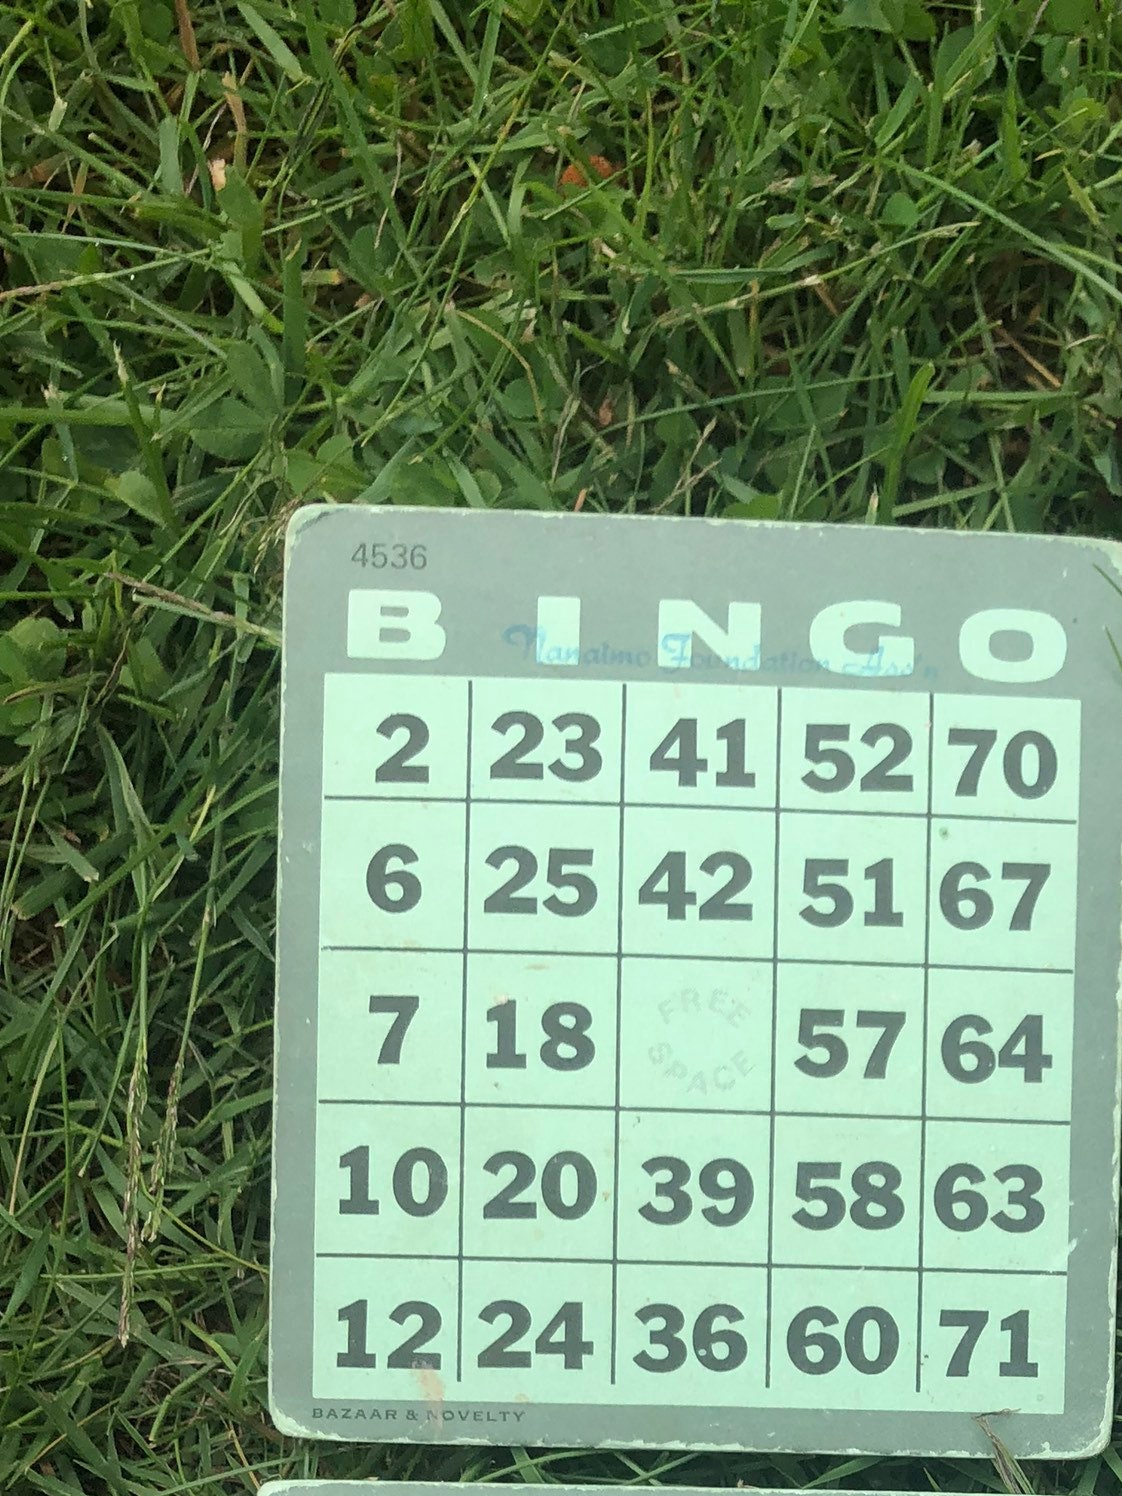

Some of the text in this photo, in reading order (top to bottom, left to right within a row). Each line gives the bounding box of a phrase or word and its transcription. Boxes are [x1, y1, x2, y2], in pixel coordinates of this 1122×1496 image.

[350, 542, 428, 570] 4536
[375, 711, 1057, 799] 2 23 41 52 70
[366, 844, 1050, 930] 6 25 42 51 67
[369, 995, 1052, 1083] 7 18 57 64
[339, 1146, 1045, 1233] 10 20 39 58 63
[337, 1299, 1038, 1377] 12 24 36 60 71
[311, 1407, 526, 1423] BAZAAR & NOVELTY
